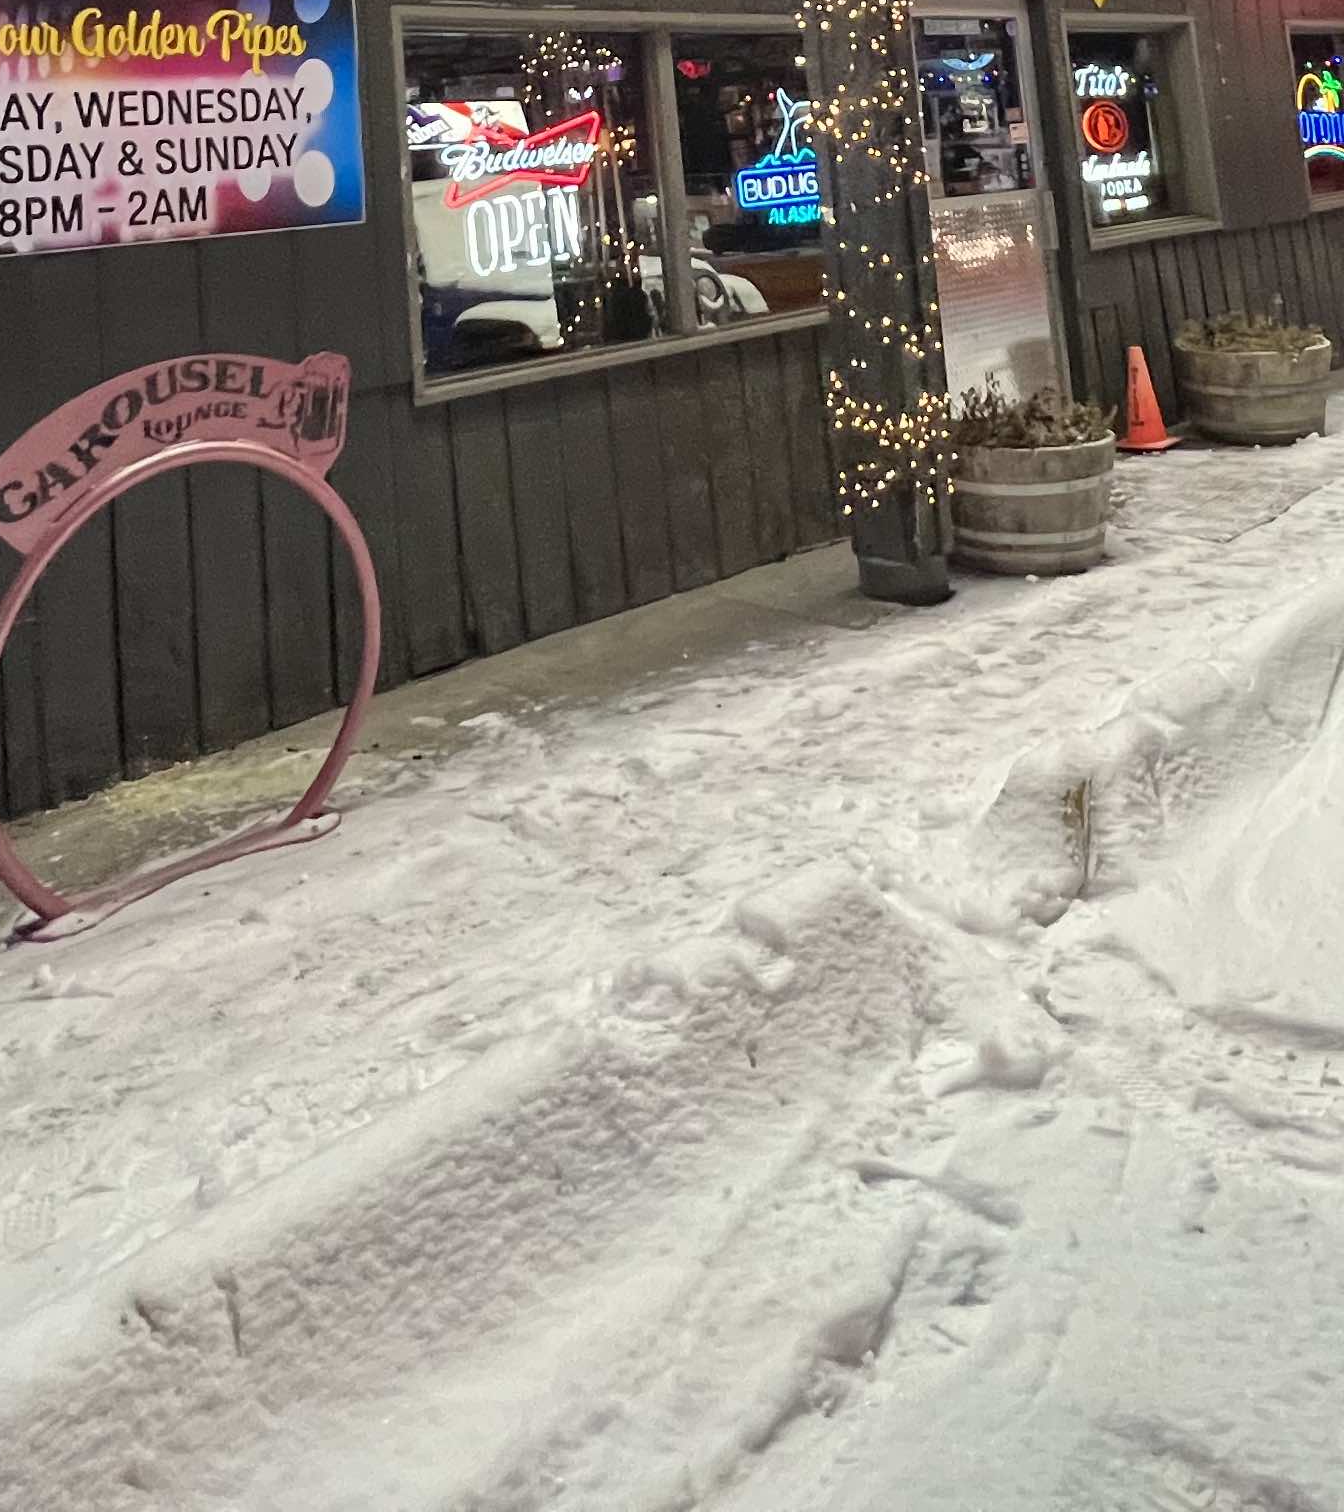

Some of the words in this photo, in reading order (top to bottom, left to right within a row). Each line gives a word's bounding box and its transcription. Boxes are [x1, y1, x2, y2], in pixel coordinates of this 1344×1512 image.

[71, 7, 206, 59] Golden
[206, 8, 307, 74] Pipes
[1075, 63, 1130, 97] Tito's
[75, 86, 313, 129] WEDNESDAY,
[118, 141, 145, 176] &
[156, 133, 299, 174] SUNDAY
[440, 137, 596, 182] Budweiser
[128, 186, 209, 228] 2AM
[743, 175, 787, 201] BUD
[788, 171, 819, 196] LIG
[467, 185, 581, 276] OPEN
[143, 401, 248, 444] LOUNGE
